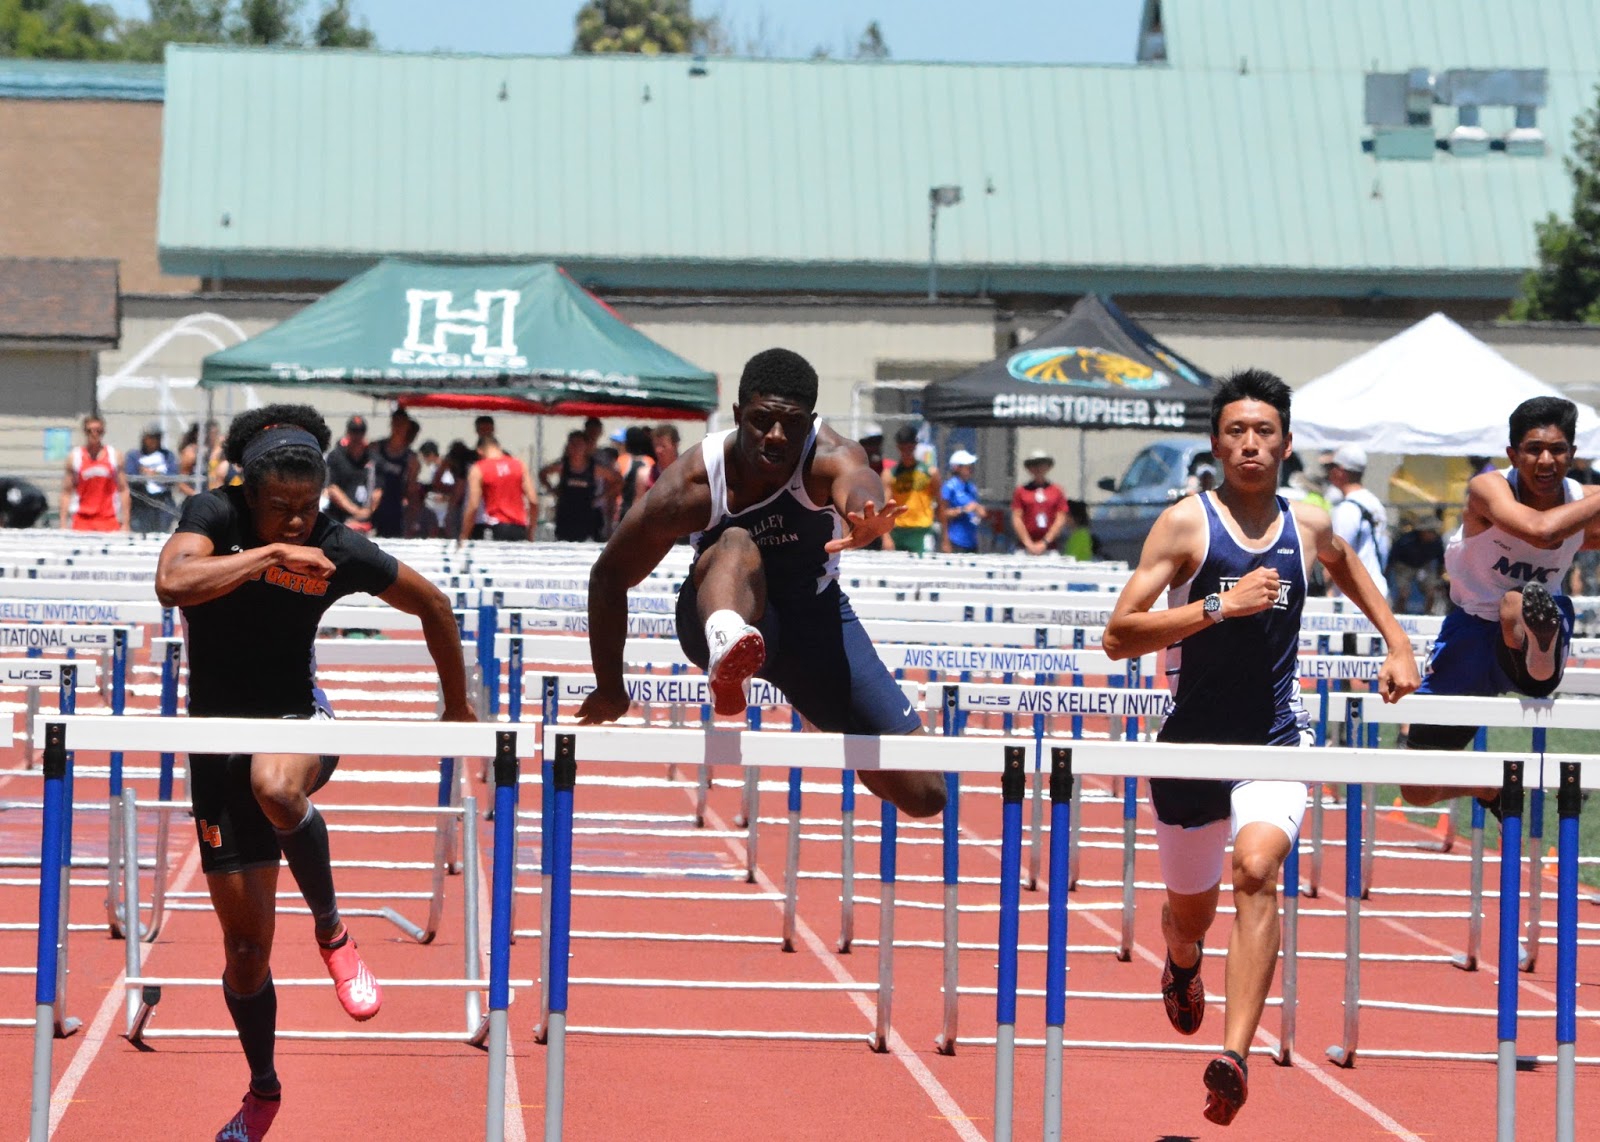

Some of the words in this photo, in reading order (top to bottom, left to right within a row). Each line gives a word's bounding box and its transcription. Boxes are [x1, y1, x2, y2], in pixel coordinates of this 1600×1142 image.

[404, 288, 520, 356] H
[391, 347, 528, 369] EAGLES
[1492, 556, 1560, 583] MVC
[43, 605, 120, 621] INVITATIONAL
[70, 633, 107, 643] UCS
[903, 649, 933, 667] AVIS
[937, 650, 987, 669] KELLEY
[990, 652, 1079, 672] INVITATIONAL
[8, 669, 53, 681] UCS
[627, 680, 652, 701] VIS
[967, 694, 1011, 706] UCS
[1017, 689, 1053, 713] AVIS
[1057, 692, 1118, 714] KELLEY
